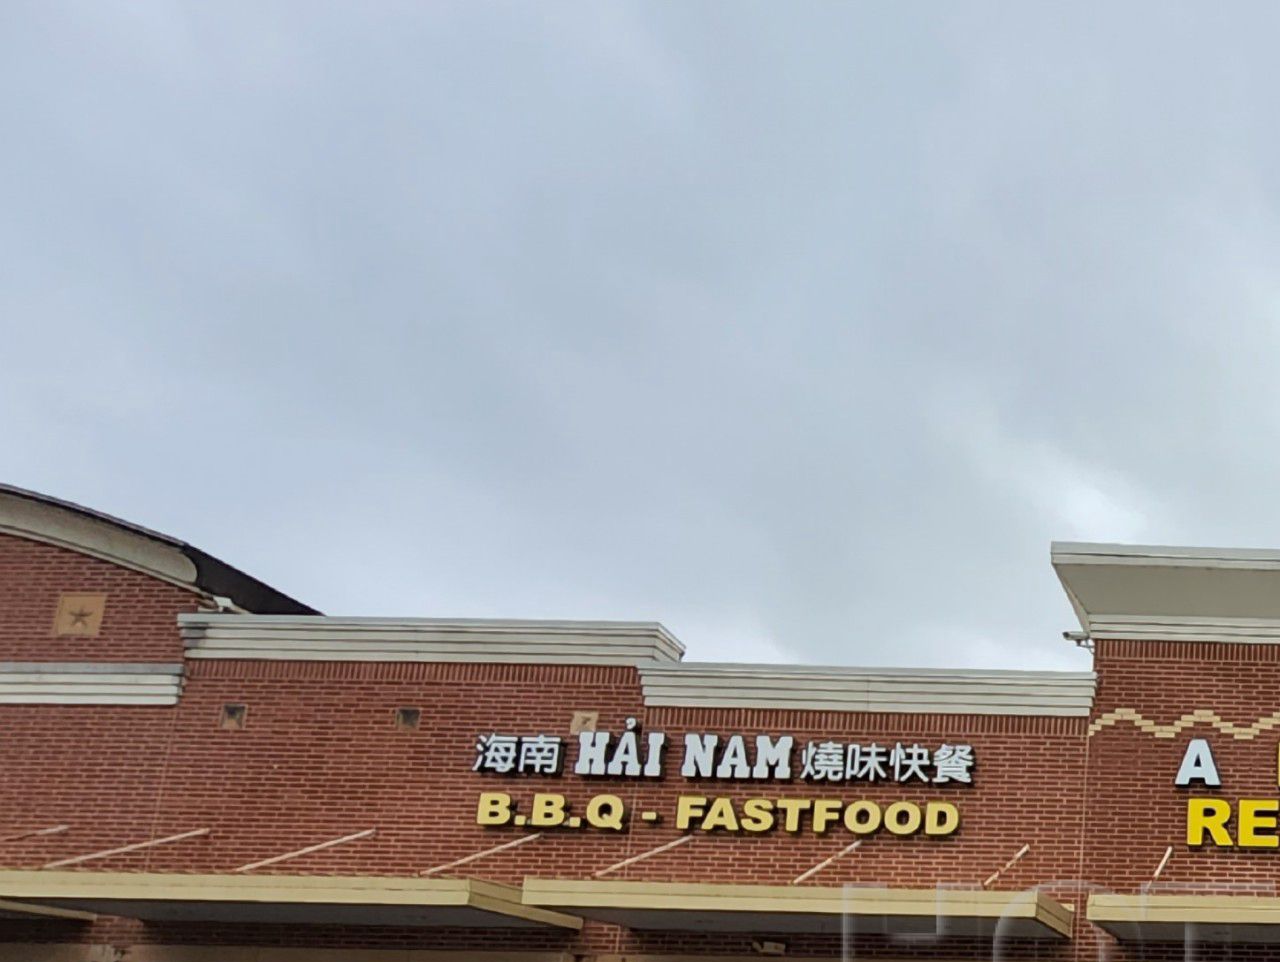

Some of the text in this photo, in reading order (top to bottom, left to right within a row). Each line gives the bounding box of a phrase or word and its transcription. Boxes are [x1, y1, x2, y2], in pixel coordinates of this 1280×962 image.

[472, 733, 562, 773] 海南
[575, 717, 794, 780] HẢI NAM
[800, 741, 974, 785] 燒味快餐
[1174, 738, 1222, 786] A
[476, 791, 625, 830] B.B.Q
[676, 796, 961, 836] FASTFOOD
